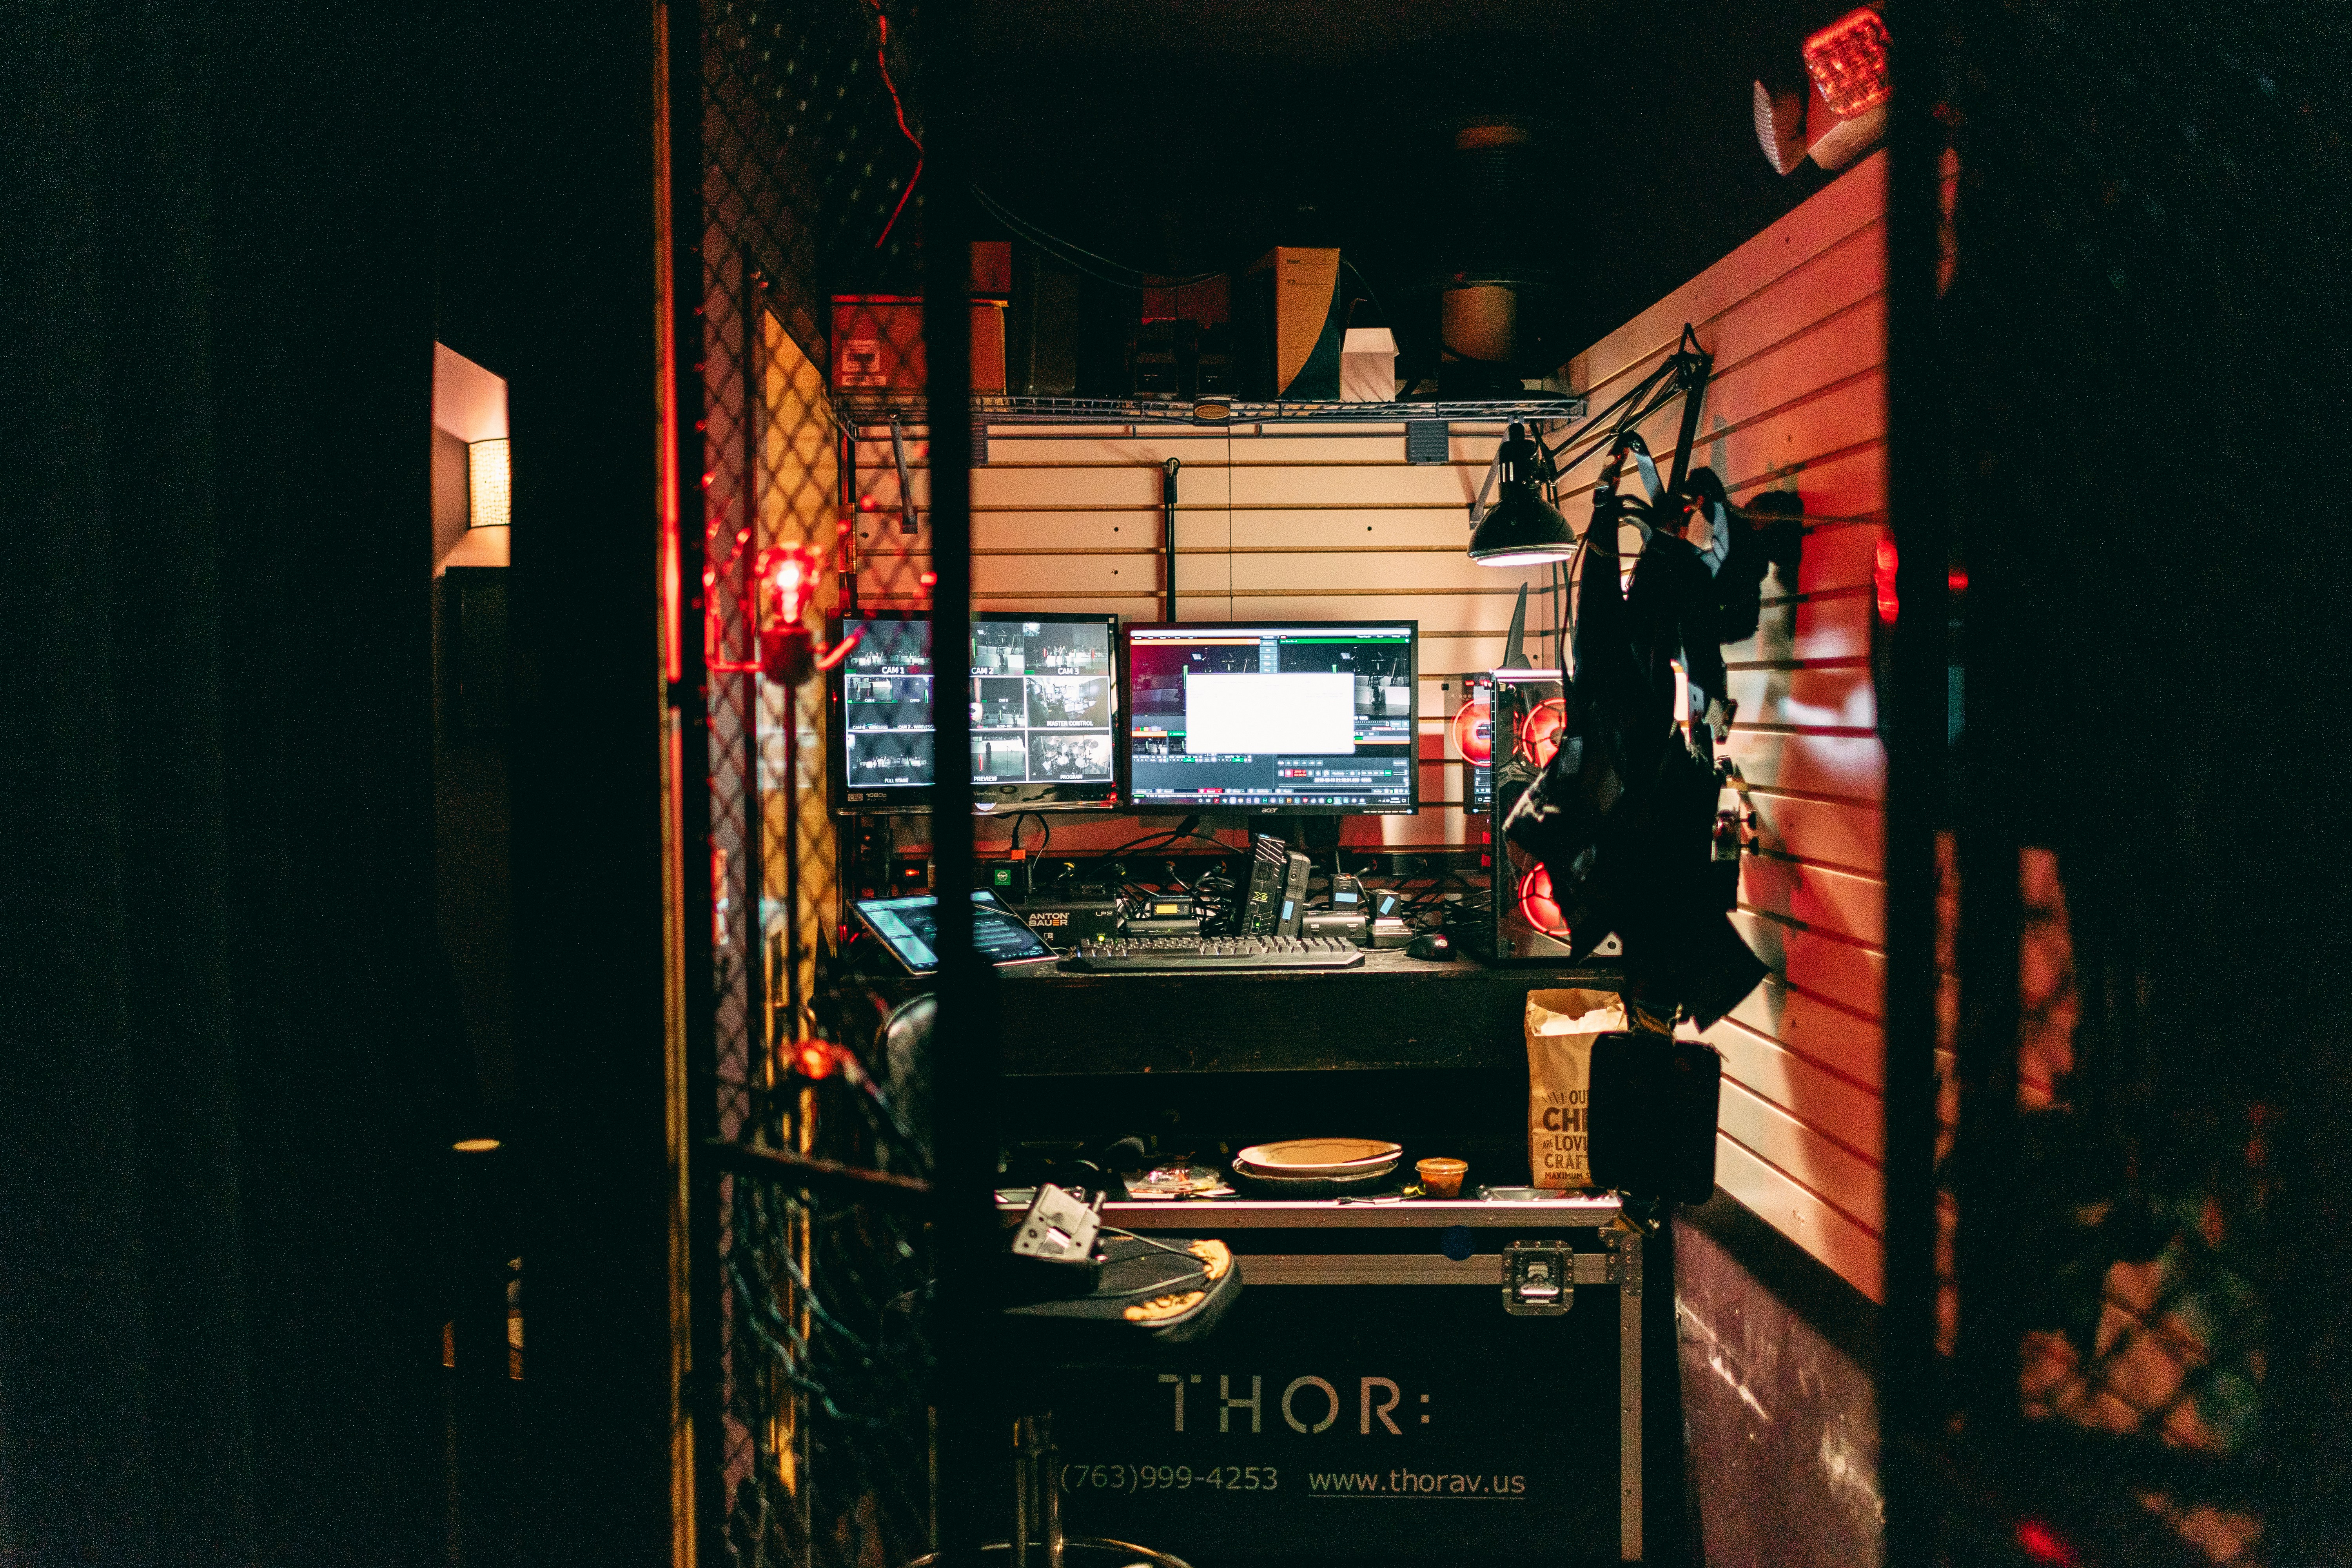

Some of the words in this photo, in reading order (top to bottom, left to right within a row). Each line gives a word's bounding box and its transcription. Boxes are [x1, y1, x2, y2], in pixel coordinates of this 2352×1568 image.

[1569, 1089, 1588, 1105] OU
[1543, 1107, 1588, 1132] CHI
[1543, 1139, 1553, 1149] ARE
[1555, 1135, 1588, 1151] LOVI
[1158, 1374, 1430, 1435] THOR:
[1061, 1464, 1278, 1494] (763)999-4253
[1308, 1468, 1526, 1494] www.thorav.us
